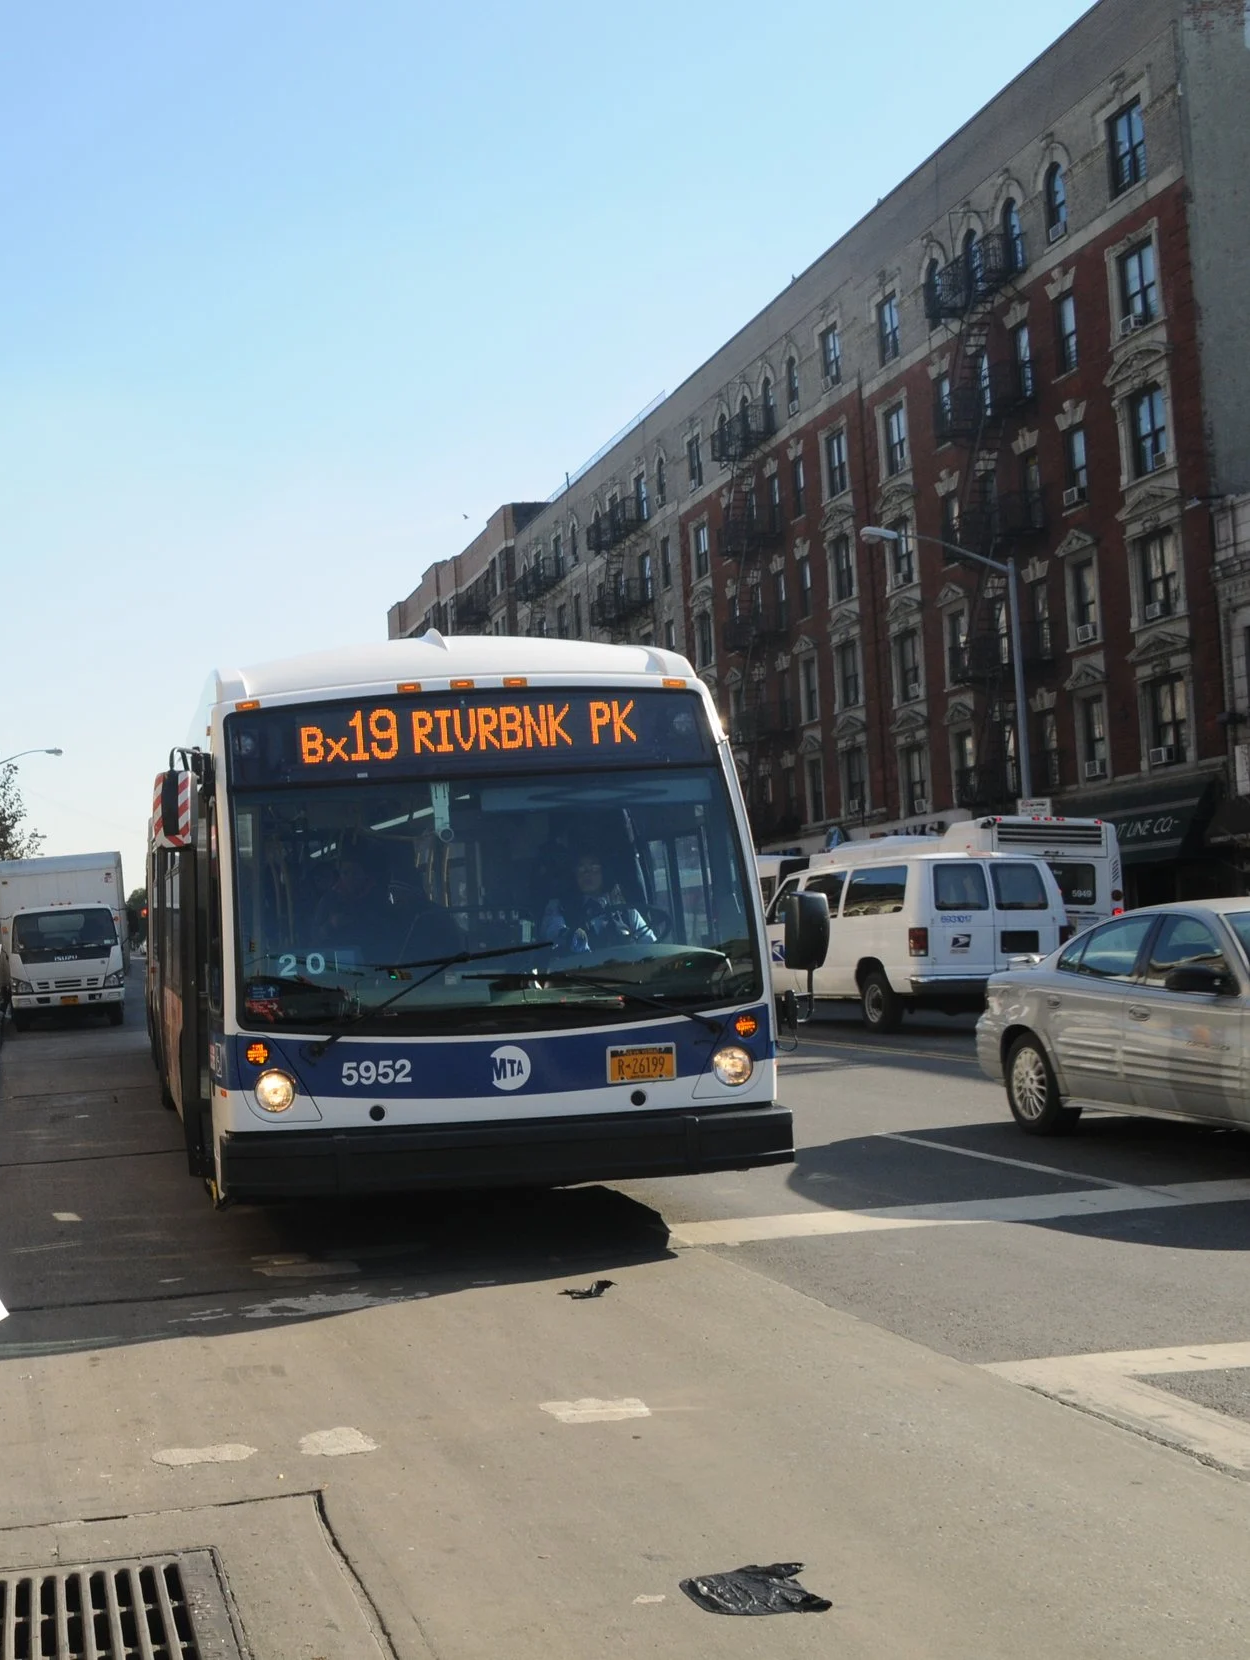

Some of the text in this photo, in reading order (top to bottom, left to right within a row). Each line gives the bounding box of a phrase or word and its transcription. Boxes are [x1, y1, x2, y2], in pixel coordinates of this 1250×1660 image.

[300, 700, 637, 764] Bx19 RIVRBNK PK
[1126, 819, 1153, 838] LINE
[341, 1058, 413, 1086] 5952
[491, 1056, 525, 1082] MTA
